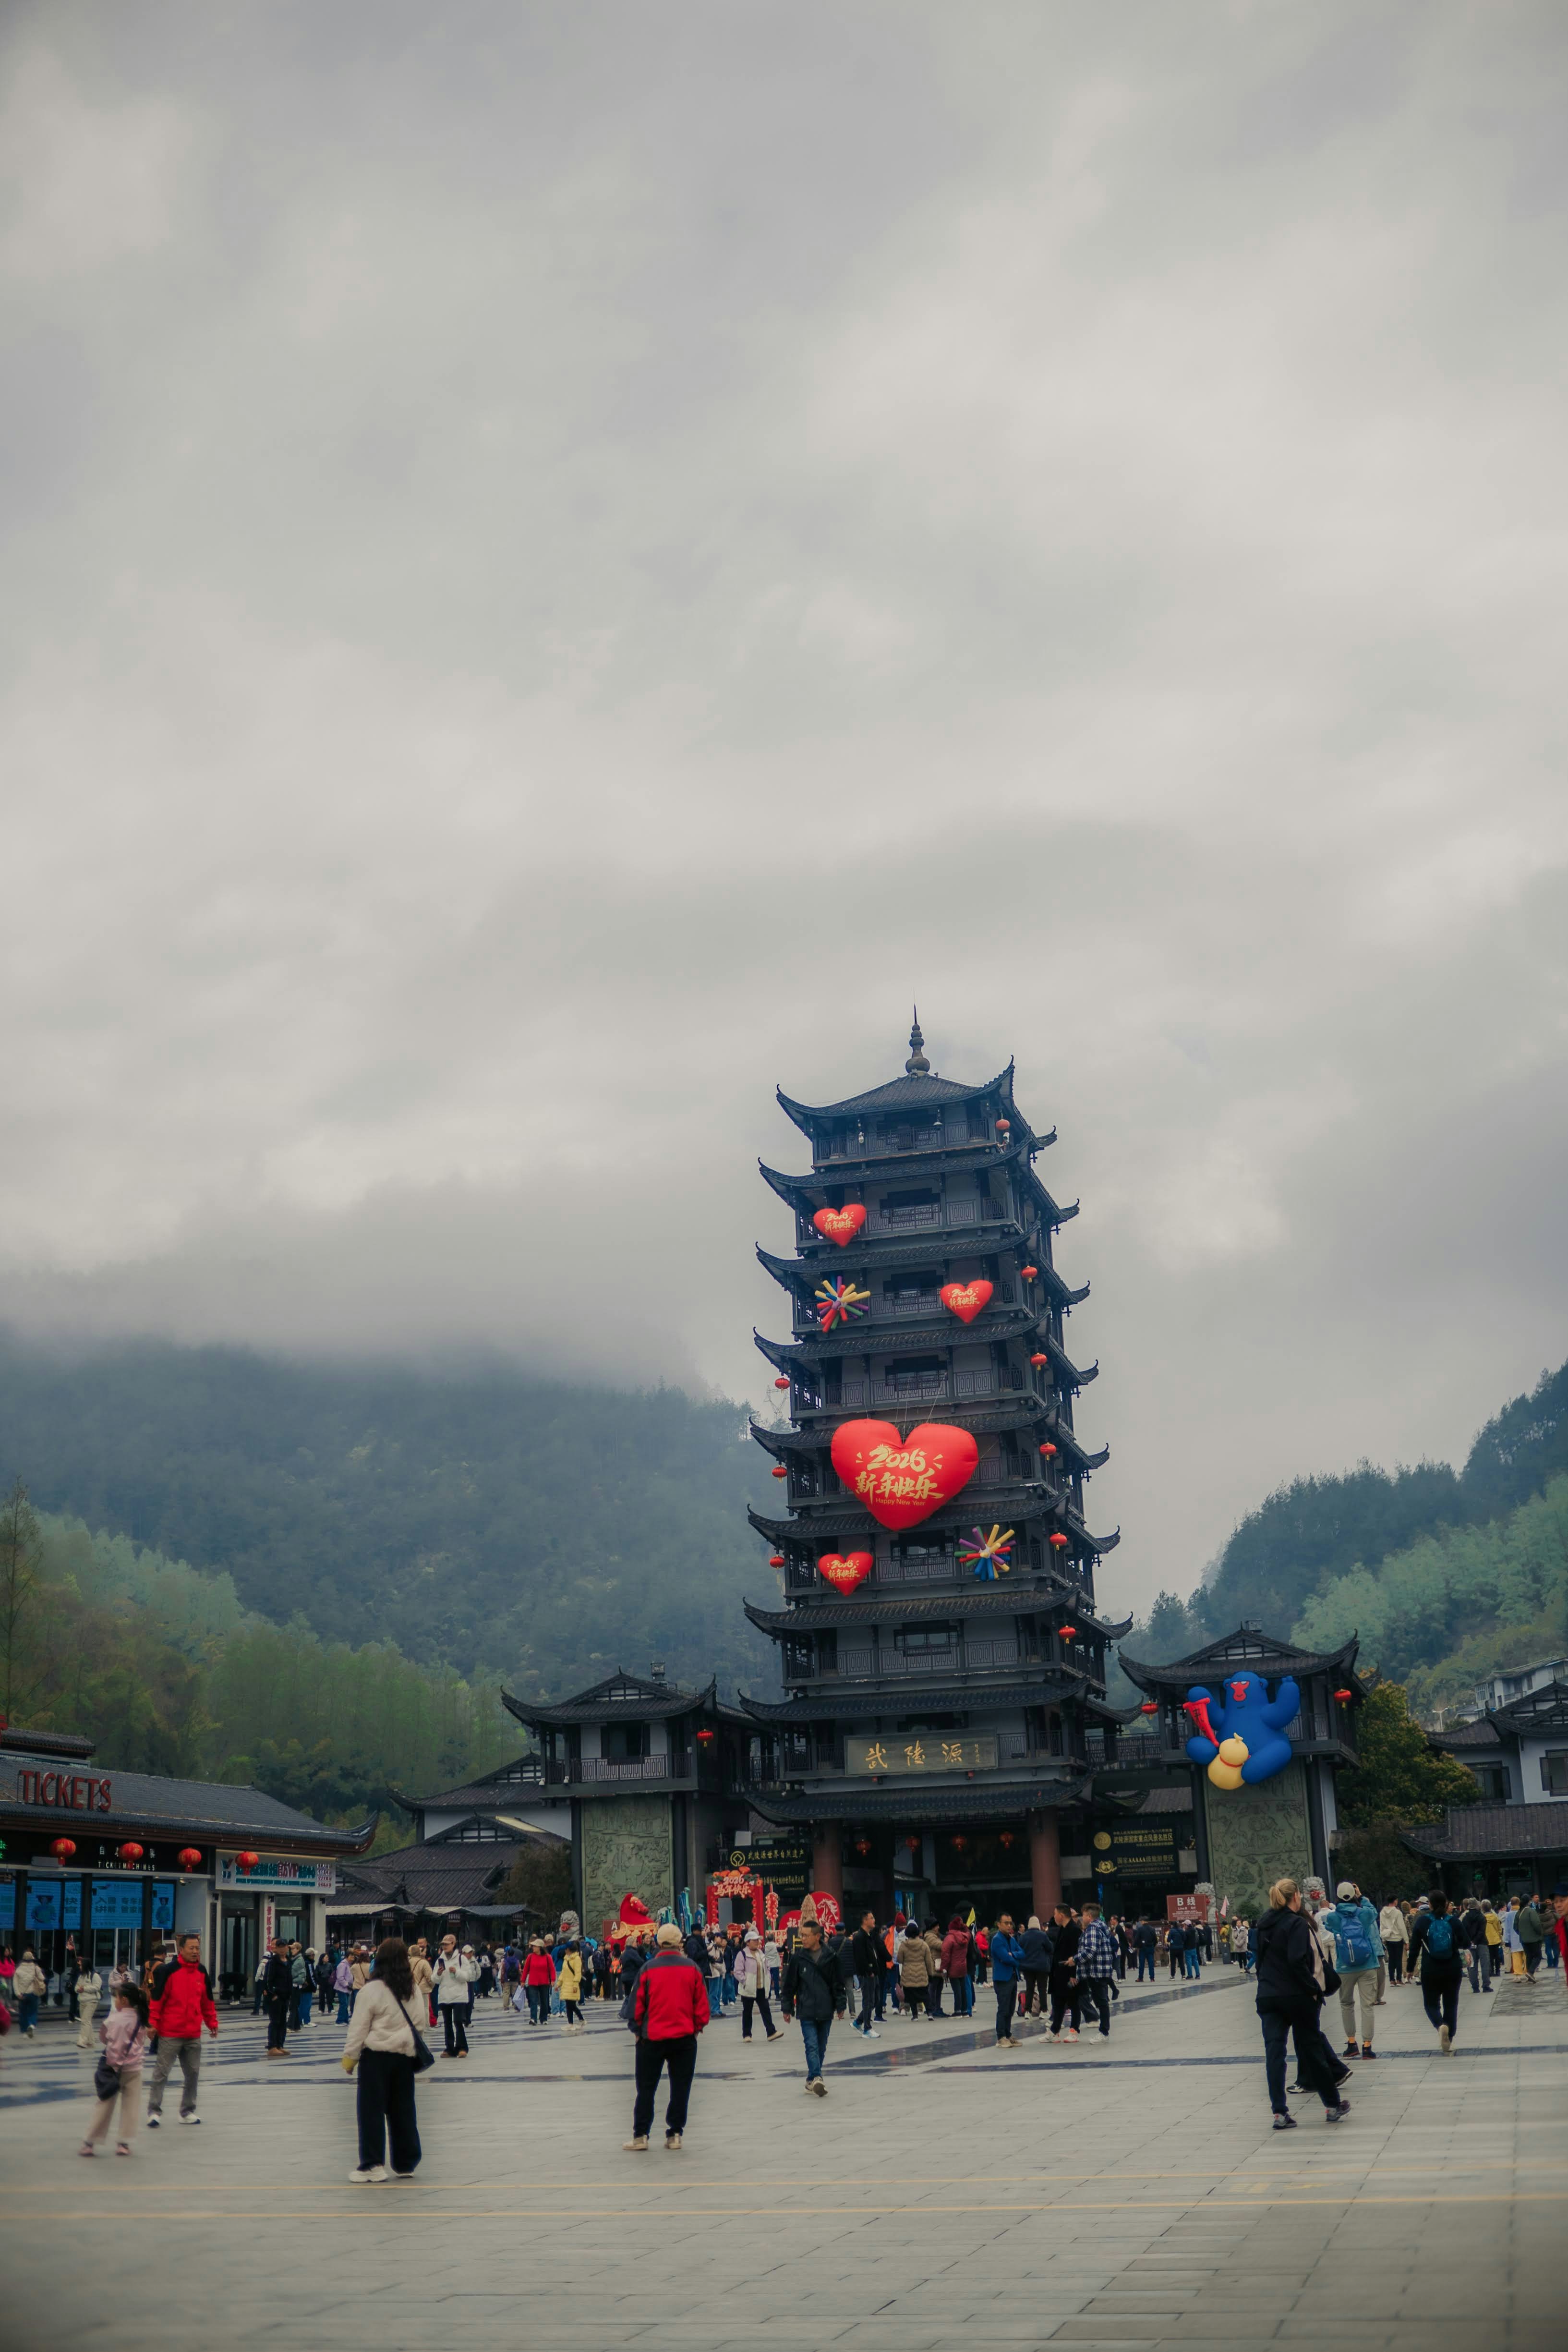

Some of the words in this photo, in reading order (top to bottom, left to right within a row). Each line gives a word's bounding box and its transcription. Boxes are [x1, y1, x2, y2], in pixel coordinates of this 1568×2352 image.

[824, 1217, 855, 1233] 新年快乐
[949, 1293, 980, 1310] 新年快乐
[867, 1444, 927, 1472] 2026
[855, 1467, 944, 1505] 新年快乐
[828, 1565, 860, 1583] 新年快乐
[865, 1740, 962, 1769] 武陵源
[20, 1770, 112, 1812] TICKETS
[1113, 1833, 1173, 1843] 武陵源国家重点风景名胜区
[748, 1849, 804, 1860] 武陵源世界自然遗产
[723, 1874, 744, 1885] 2026
[714, 1882, 752, 1898] 马年快乐
[1177, 1898, 1183, 1906] B
[1187, 1897, 1195, 1905] 线
[611, 1921, 618, 1930] A
